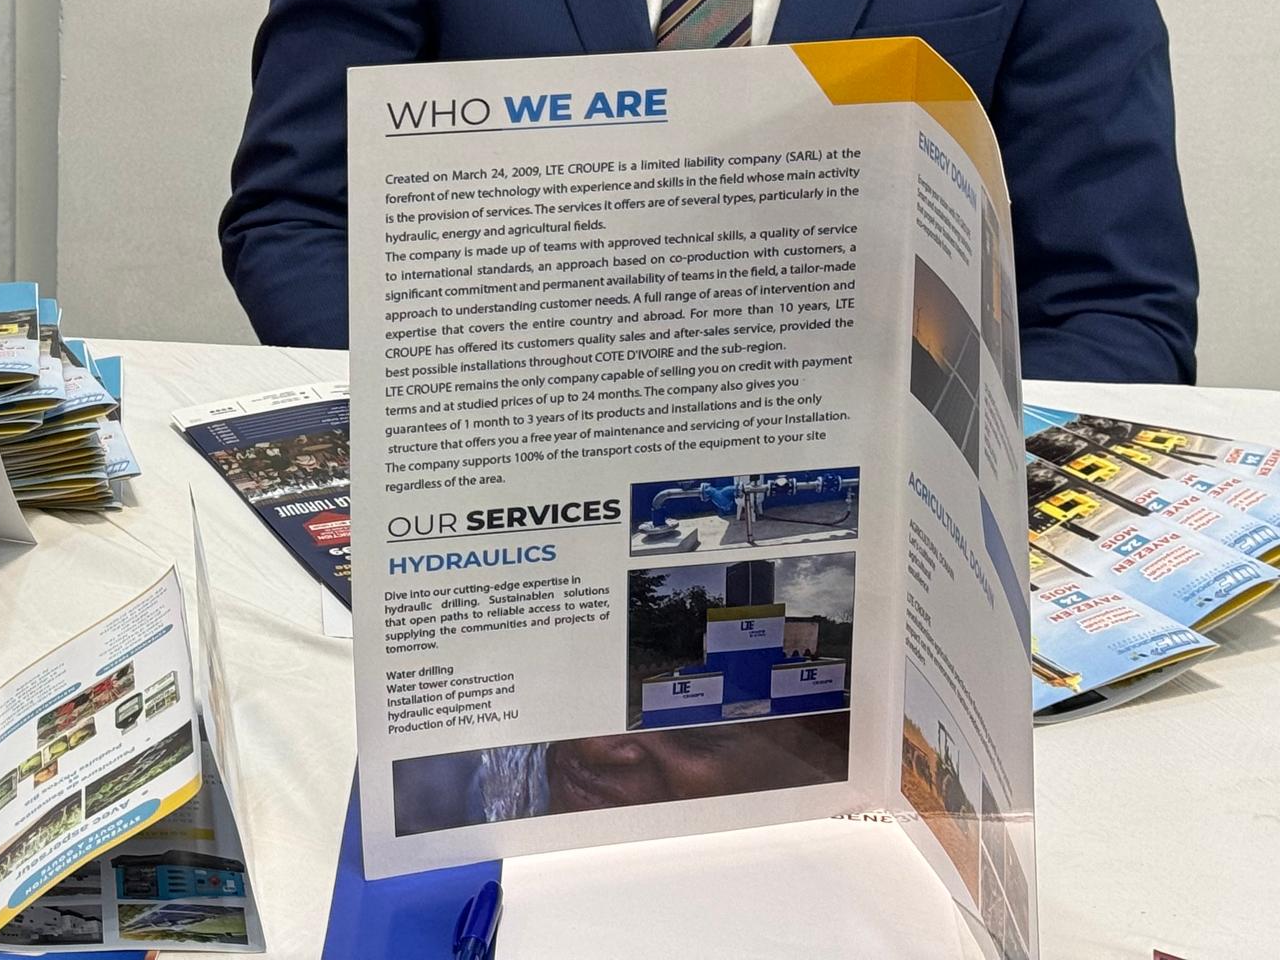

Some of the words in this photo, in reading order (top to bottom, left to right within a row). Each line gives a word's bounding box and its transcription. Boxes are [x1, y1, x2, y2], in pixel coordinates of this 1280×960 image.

[387, 98, 490, 130] WHO
[504, 93, 573, 124] WE
[584, 88, 668, 120] ARE
[919, 130, 950, 176] ENERGY
[384, 170, 430, 185] Created
[432, 172, 448, 182] on
[451, 167, 487, 181] March
[490, 167, 508, 180] 24,
[511, 165, 542, 178] 2009,
[545, 163, 564, 176] LTE
[567, 161, 615, 174] CROUPE
[617, 160, 627, 172] is
[629, 162, 637, 171] a
[640, 157, 680, 170] limited
[683, 155, 725, 169] liability
[727, 153, 782, 167] company
[785, 149, 822, 164] (SARL)
[825, 149, 838, 160] at
[841, 147, 861, 159] the
[385, 229, 440, 245] hydraulic,
[441, 228, 482, 240] energy
[482, 224, 506, 237] and
[507, 220, 571, 237] agricultural
[573, 218, 606, 231] fields.
[385, 478, 442, 494] regardless
[443, 475, 457, 488] of
[457, 474, 477, 487] the
[478, 474, 506, 485] area.
[274, 497, 336, 518] TURQUIE
[388, 513, 457, 537] OUR
[467, 499, 622, 531] SERVICES
[908, 471, 969, 562] AGRICULTURAL
[1100, 526, 1138, 550] MOIS
[1120, 539, 1143, 553] 24
[1135, 533, 1181, 559] PAYEZ
[389, 544, 557, 575] HYDRAULICS
[1113, 560, 1135, 573] EN
[384, 590, 408, 602] Dive
[409, 588, 431, 599] into
[432, 587, 451, 597] our
[452, 580, 520, 595] cutting-edge
[521, 576, 569, 590] expertise
[570, 574, 581, 585] in
[1040, 584, 1080, 601] MOIS
[1060, 592, 1083, 606] 24
[384, 616, 407, 628] that
[408, 615, 436, 627] open
[439, 610, 469, 624] paths
[471, 609, 484, 619] to
[486, 604, 525, 618] reliable
[527, 603, 561, 614] access
[563, 601, 576, 611] to
[578, 599, 610, 610] water,
[1049, 609, 1070, 622] EN
[1071, 594, 1122, 614] PAYEZ
[385, 641, 439, 654] tomorrow.
[385, 669, 417, 681] Water
[417, 665, 454, 677] drilling
[385, 683, 417, 694] Water
[417, 679, 448, 690] tower
[449, 671, 514, 687] construction
[386, 692, 443, 708] Installation
[444, 689, 456, 700] of
[457, 687, 493, 701] pumps
[494, 683, 515, 695] and
[387, 705, 434, 721] hydraulic
[435, 699, 492, 716] equipment
[387, 719, 444, 735] Production
[445, 715, 457, 727] of
[457, 713, 475, 726] HV,
[476, 711, 501, 724] HVA,
[502, 708, 519, 721] HU
[92, 799, 131, 825] Avec
[16, 824, 89, 881] asperseur
